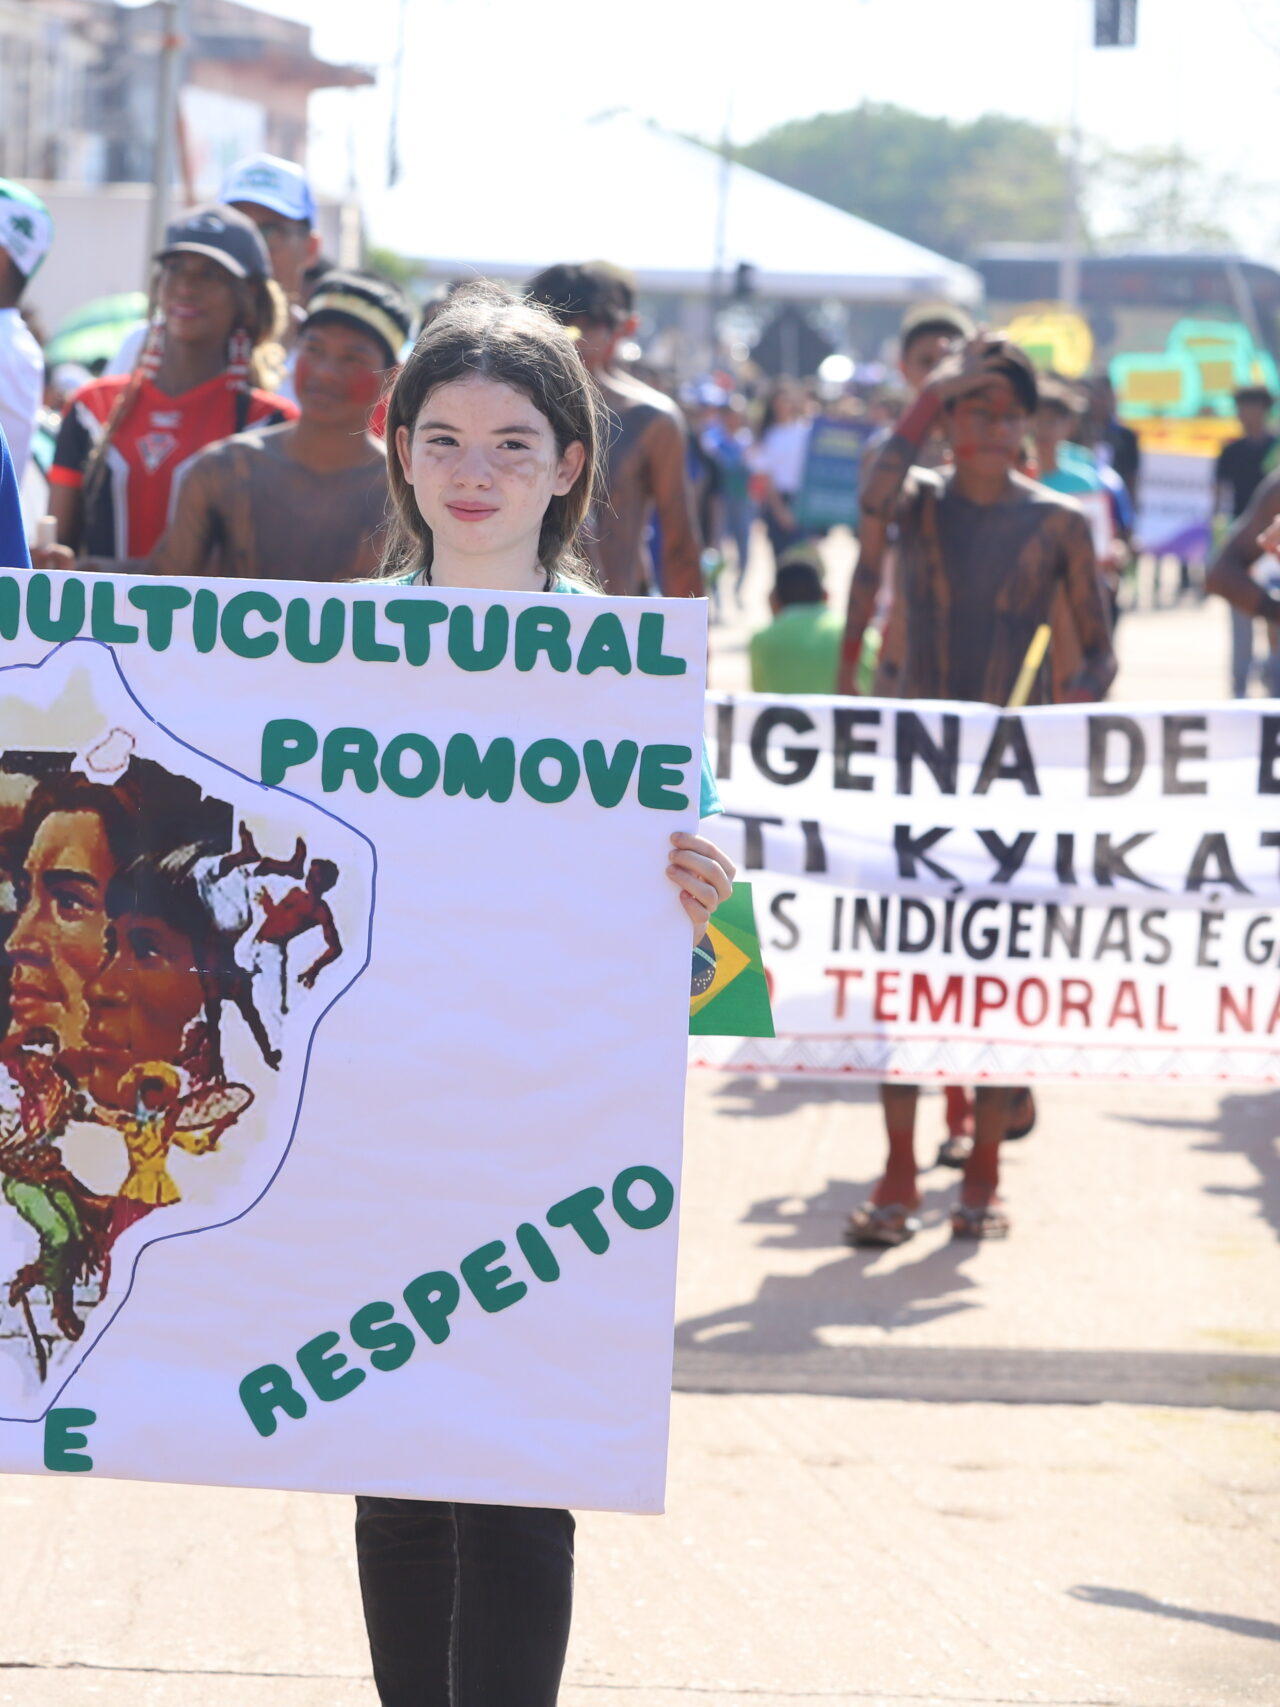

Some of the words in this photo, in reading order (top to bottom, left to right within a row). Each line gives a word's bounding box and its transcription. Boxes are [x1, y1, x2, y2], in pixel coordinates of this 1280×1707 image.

[261, 718, 692, 811] PROMOVE
[1087, 714, 1208, 798] DE
[758, 892, 801, 952] S
[1196, 892, 1224, 967] É
[823, 967, 1179, 1032] TEMPORAL
[239, 1165, 674, 1437] RESPEITO
[44, 1407, 97, 1472] E
